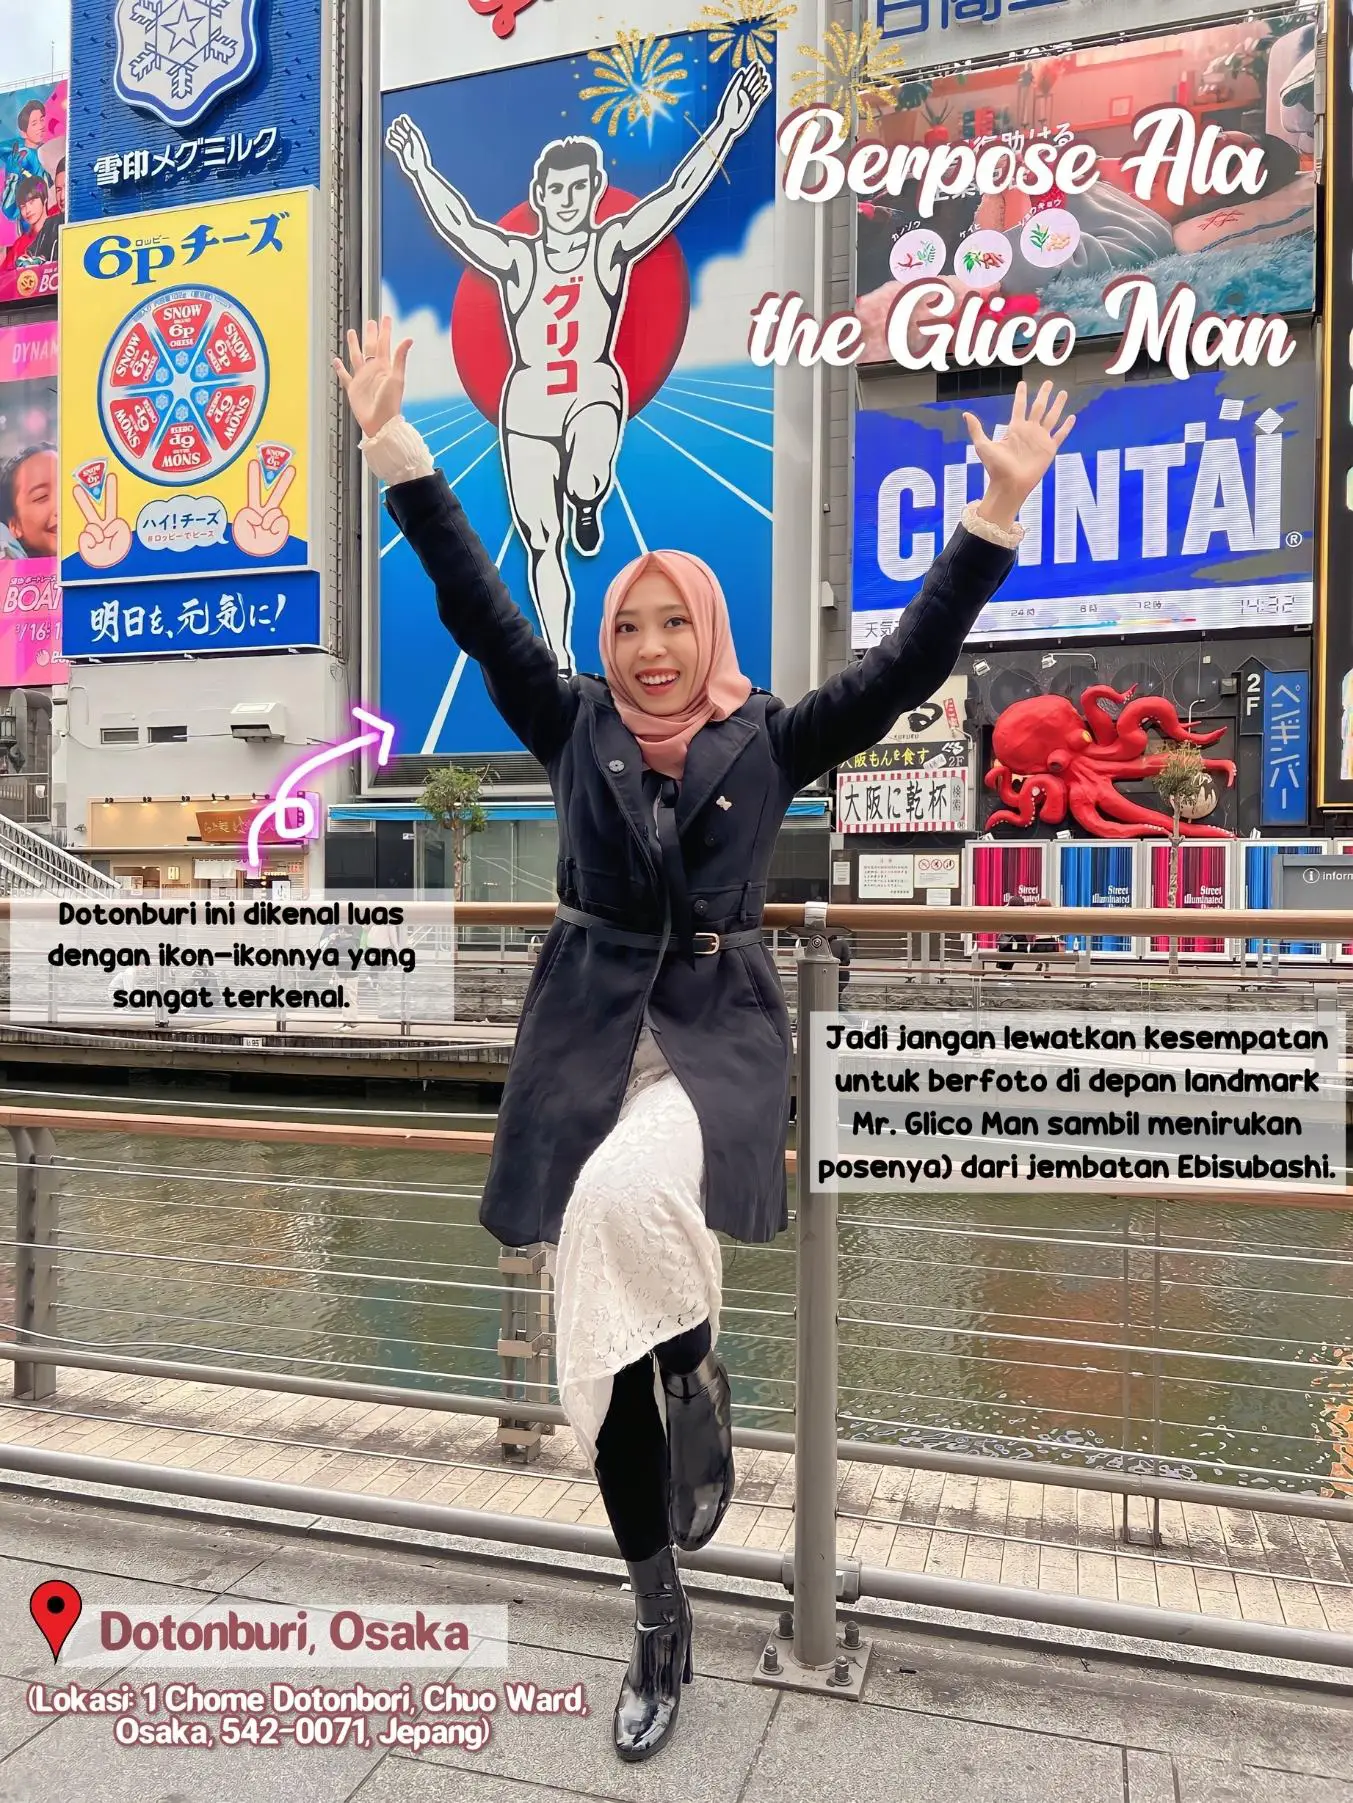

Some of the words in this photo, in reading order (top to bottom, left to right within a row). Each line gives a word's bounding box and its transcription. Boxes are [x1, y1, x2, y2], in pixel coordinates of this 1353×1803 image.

[93, 127, 278, 186] 雪印メグミルク
[163, 304, 203, 320] SNOW
[543, 276, 583, 396] グリコ
[162, 452, 201, 468] SNOW
[1246, 673, 1261, 716] 2F
[948, 755, 965, 767] 2F
[844, 780, 948, 822] 大阪に乾杯
[1108, 885, 1129, 895] Street
[1200, 885, 1222, 895] Street
